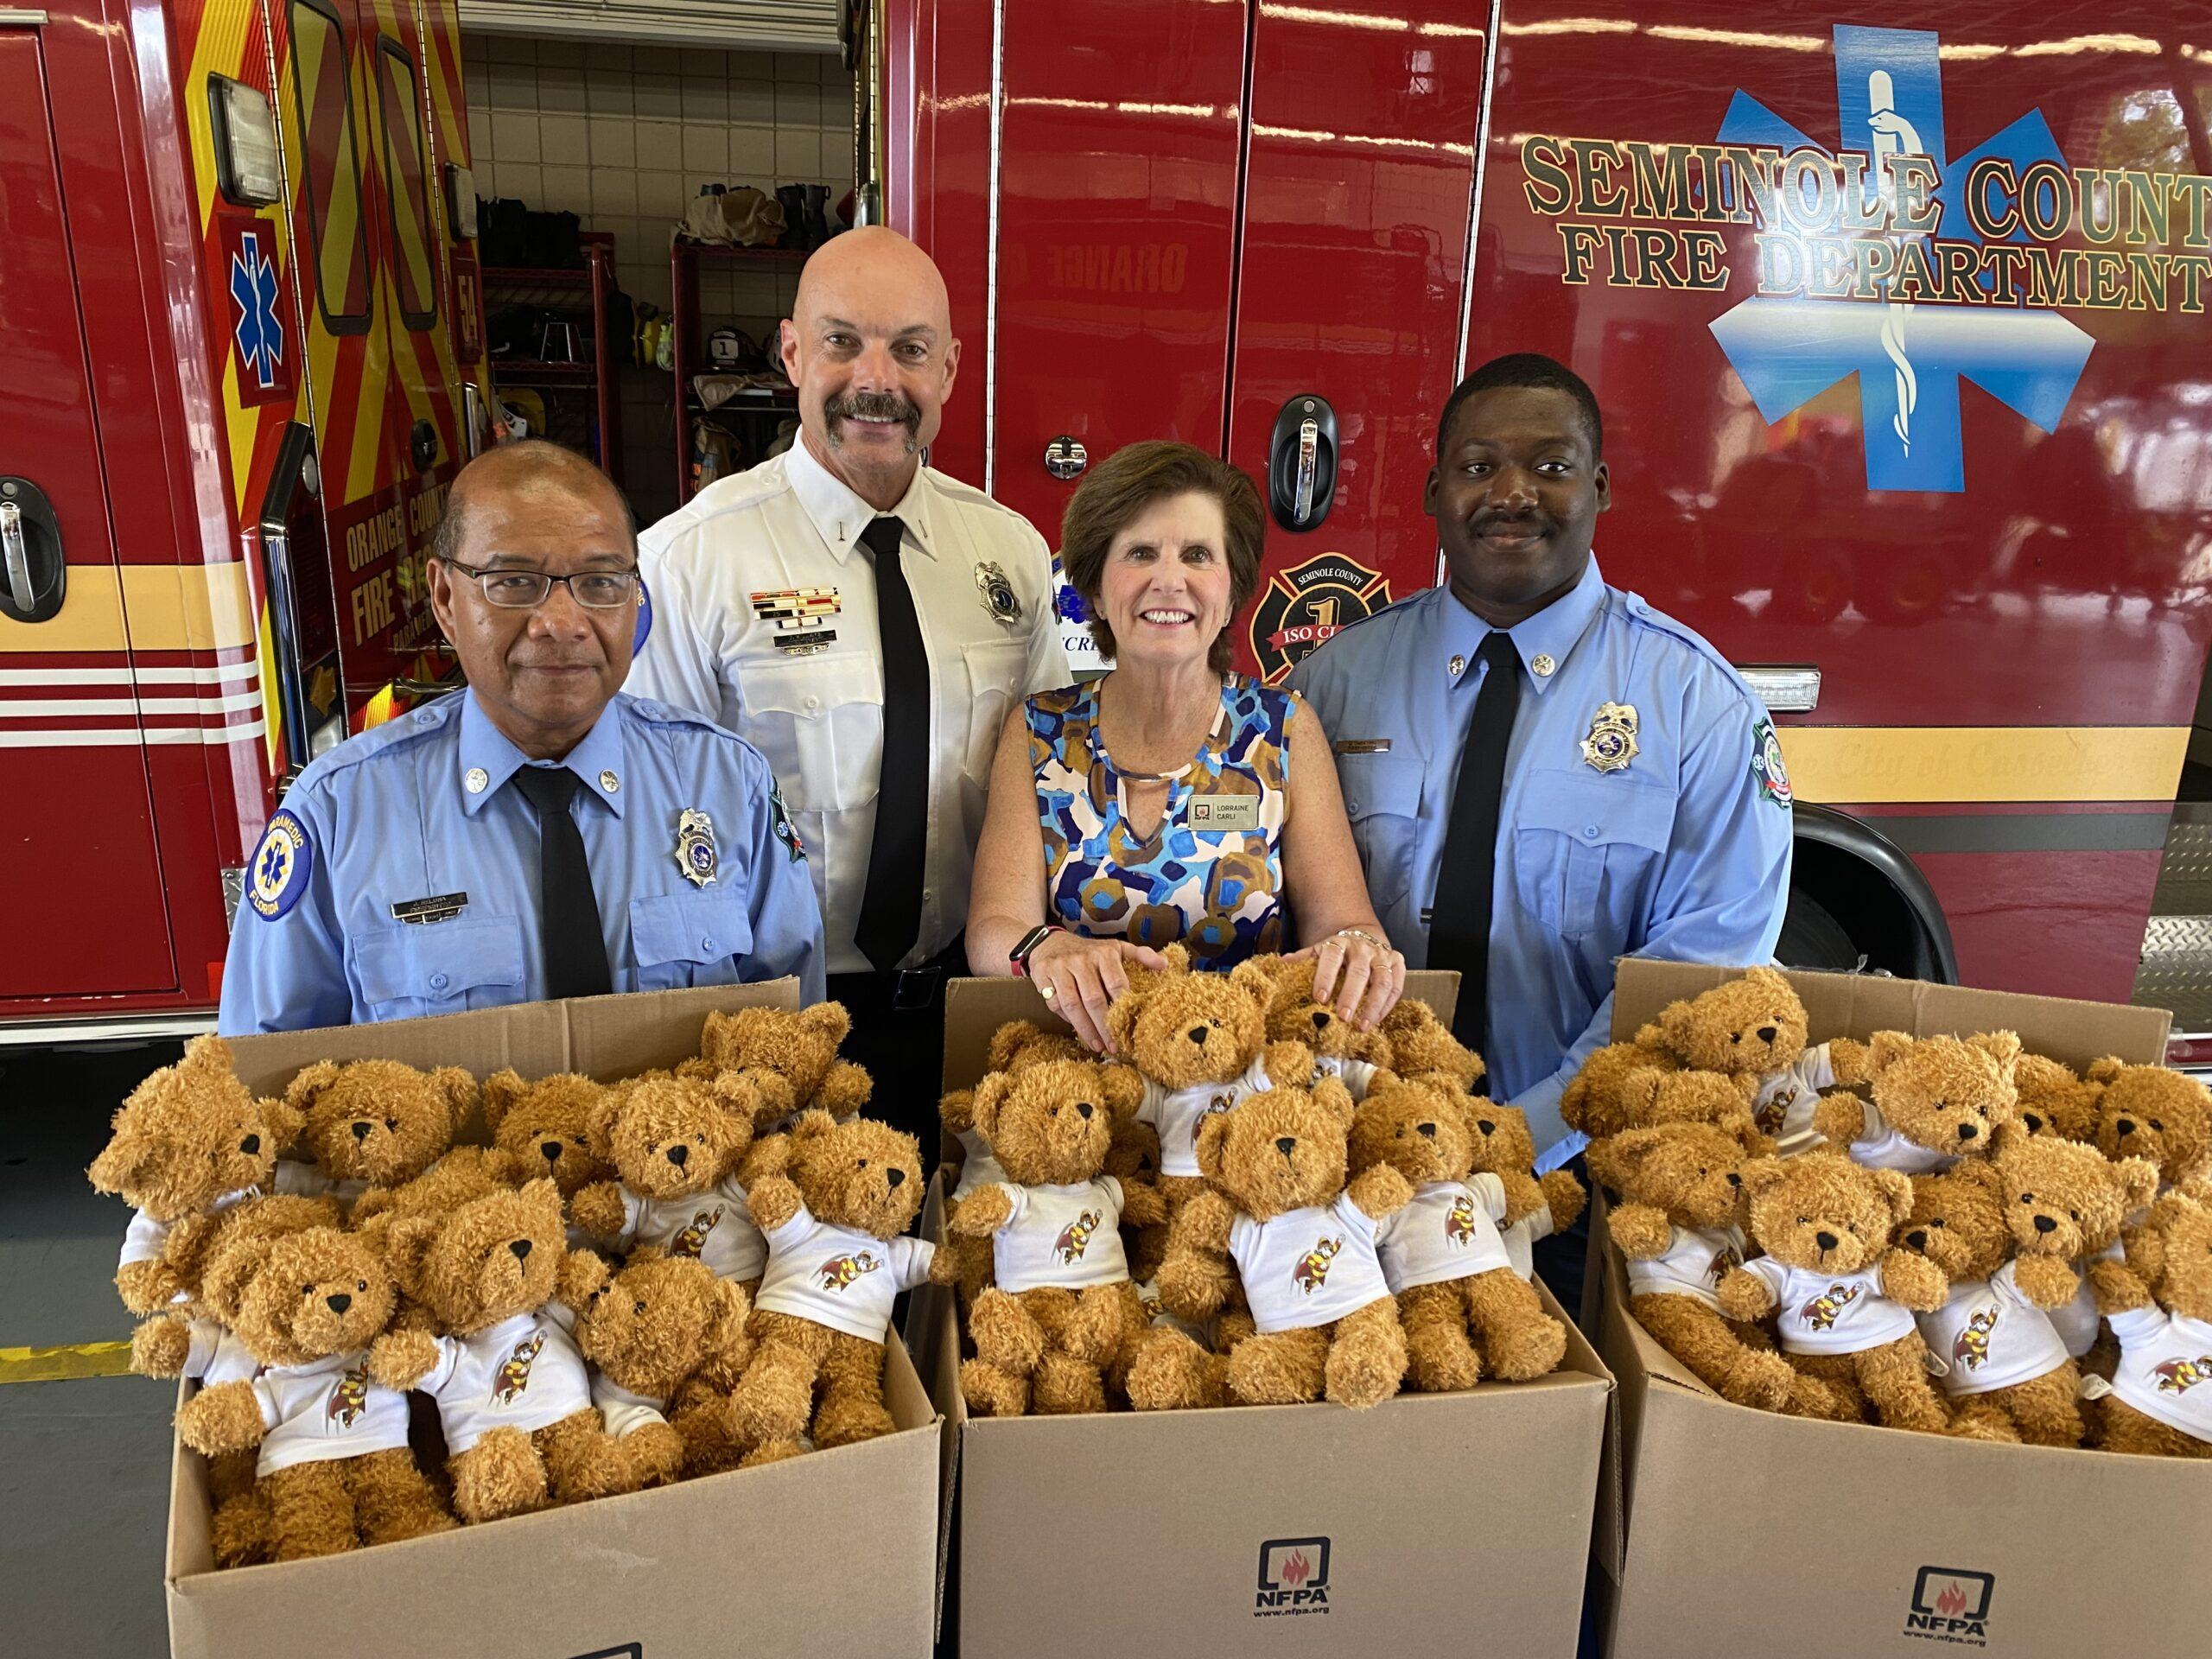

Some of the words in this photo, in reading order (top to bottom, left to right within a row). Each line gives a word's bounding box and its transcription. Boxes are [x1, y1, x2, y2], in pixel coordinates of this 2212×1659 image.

[1521, 133, 1946, 233] SEMINOLE
[1967, 159, 2212, 249] COUNT
[1556, 222, 1731, 292] FIRE
[1754, 232, 2212, 313] DEPARTMENT
[457, 274, 479, 343] 54
[719, 341, 728, 356] 1
[346, 503, 404, 573] ORANGE
[1298, 568, 1333, 586] SEMINOLE
[1334, 568, 1363, 586] COUNTY
[351, 569, 396, 646] FIRE
[1283, 627, 1313, 644] ISO
[268, 815, 304, 849] PARAMEDIC
[249, 889, 279, 916] FLORIDA
[1256, 1588, 1328, 1607] NFPA
[1253, 1607, 1330, 1618] www.nfpa.org
[1906, 1613, 1986, 1637] NFPA
[1903, 1630, 1986, 1648] www.nfpa.org
